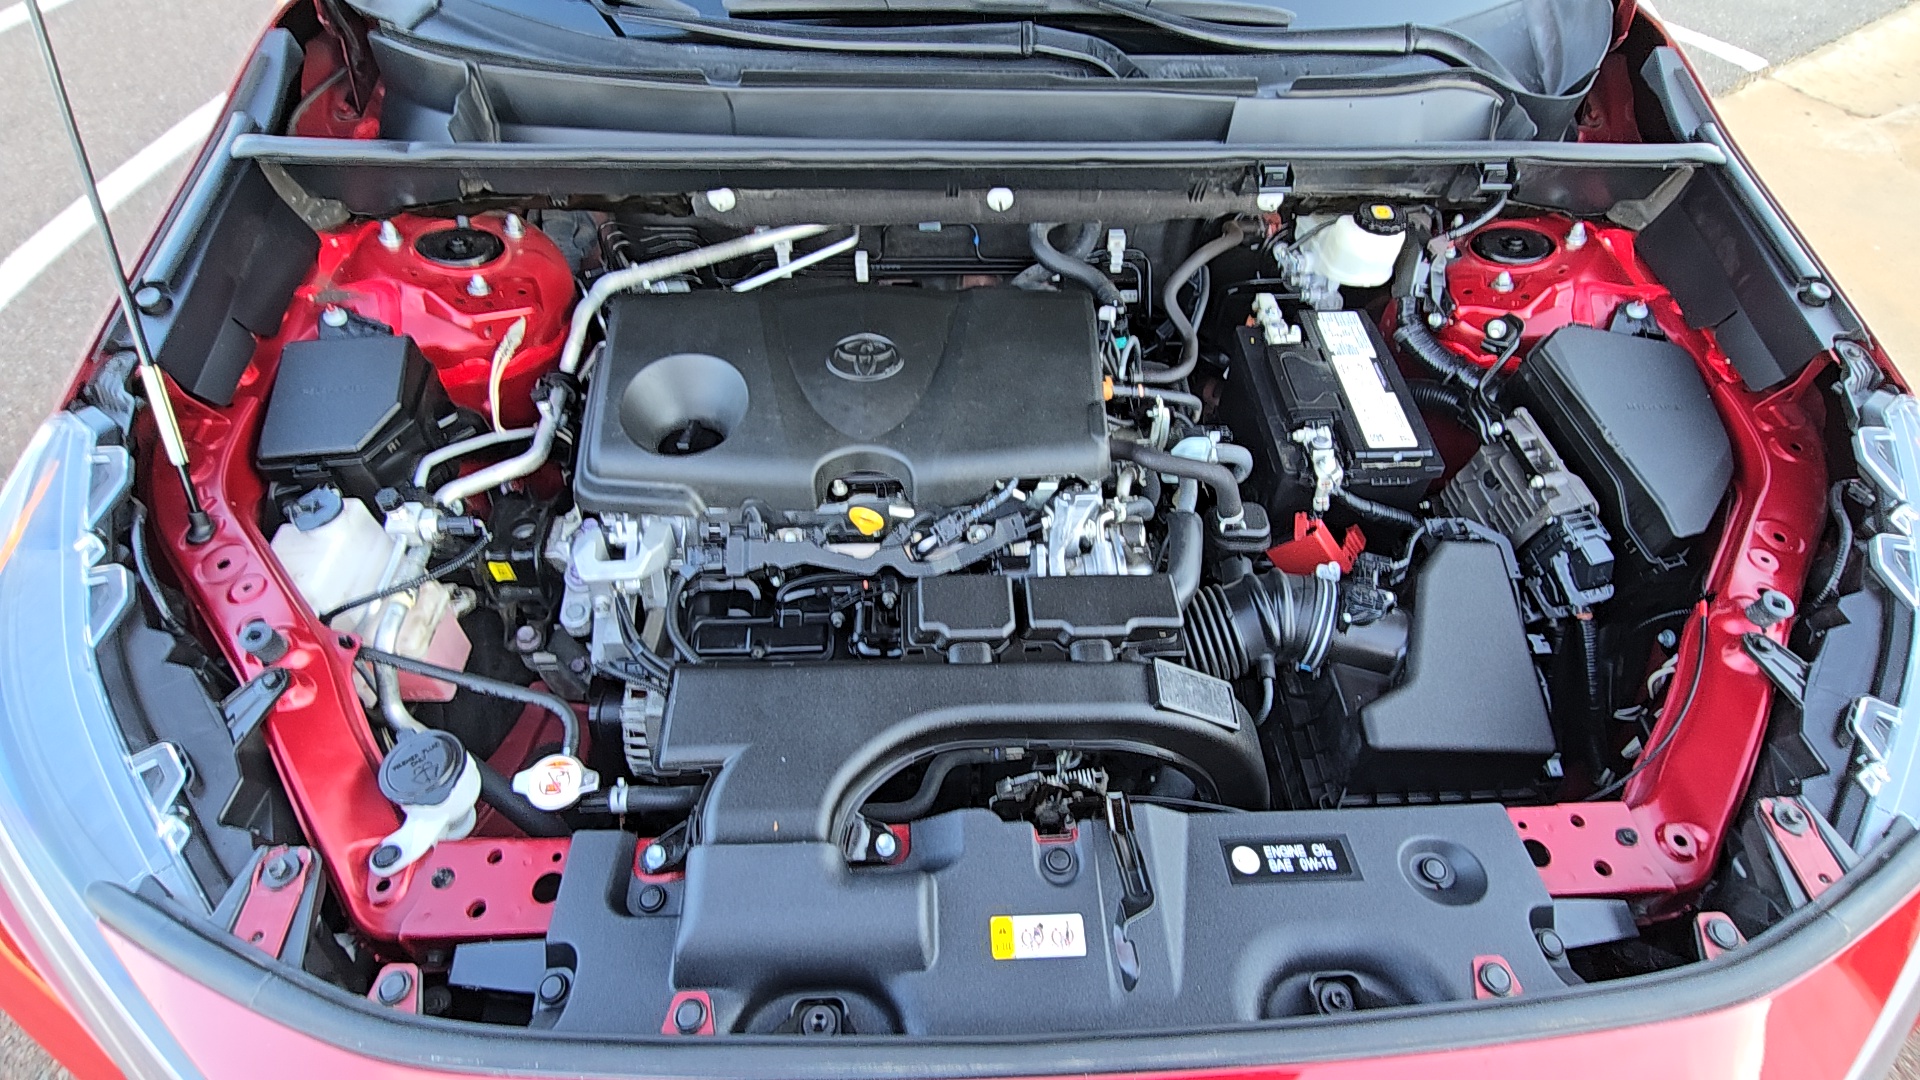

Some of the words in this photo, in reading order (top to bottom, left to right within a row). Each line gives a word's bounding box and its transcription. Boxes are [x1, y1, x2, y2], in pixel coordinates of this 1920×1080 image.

[387, 438, 401, 454] R1
[1263, 844, 1307, 859] ENGINE
[1311, 843, 1333, 857] OIL
[1268, 858, 1294, 872] SAE
